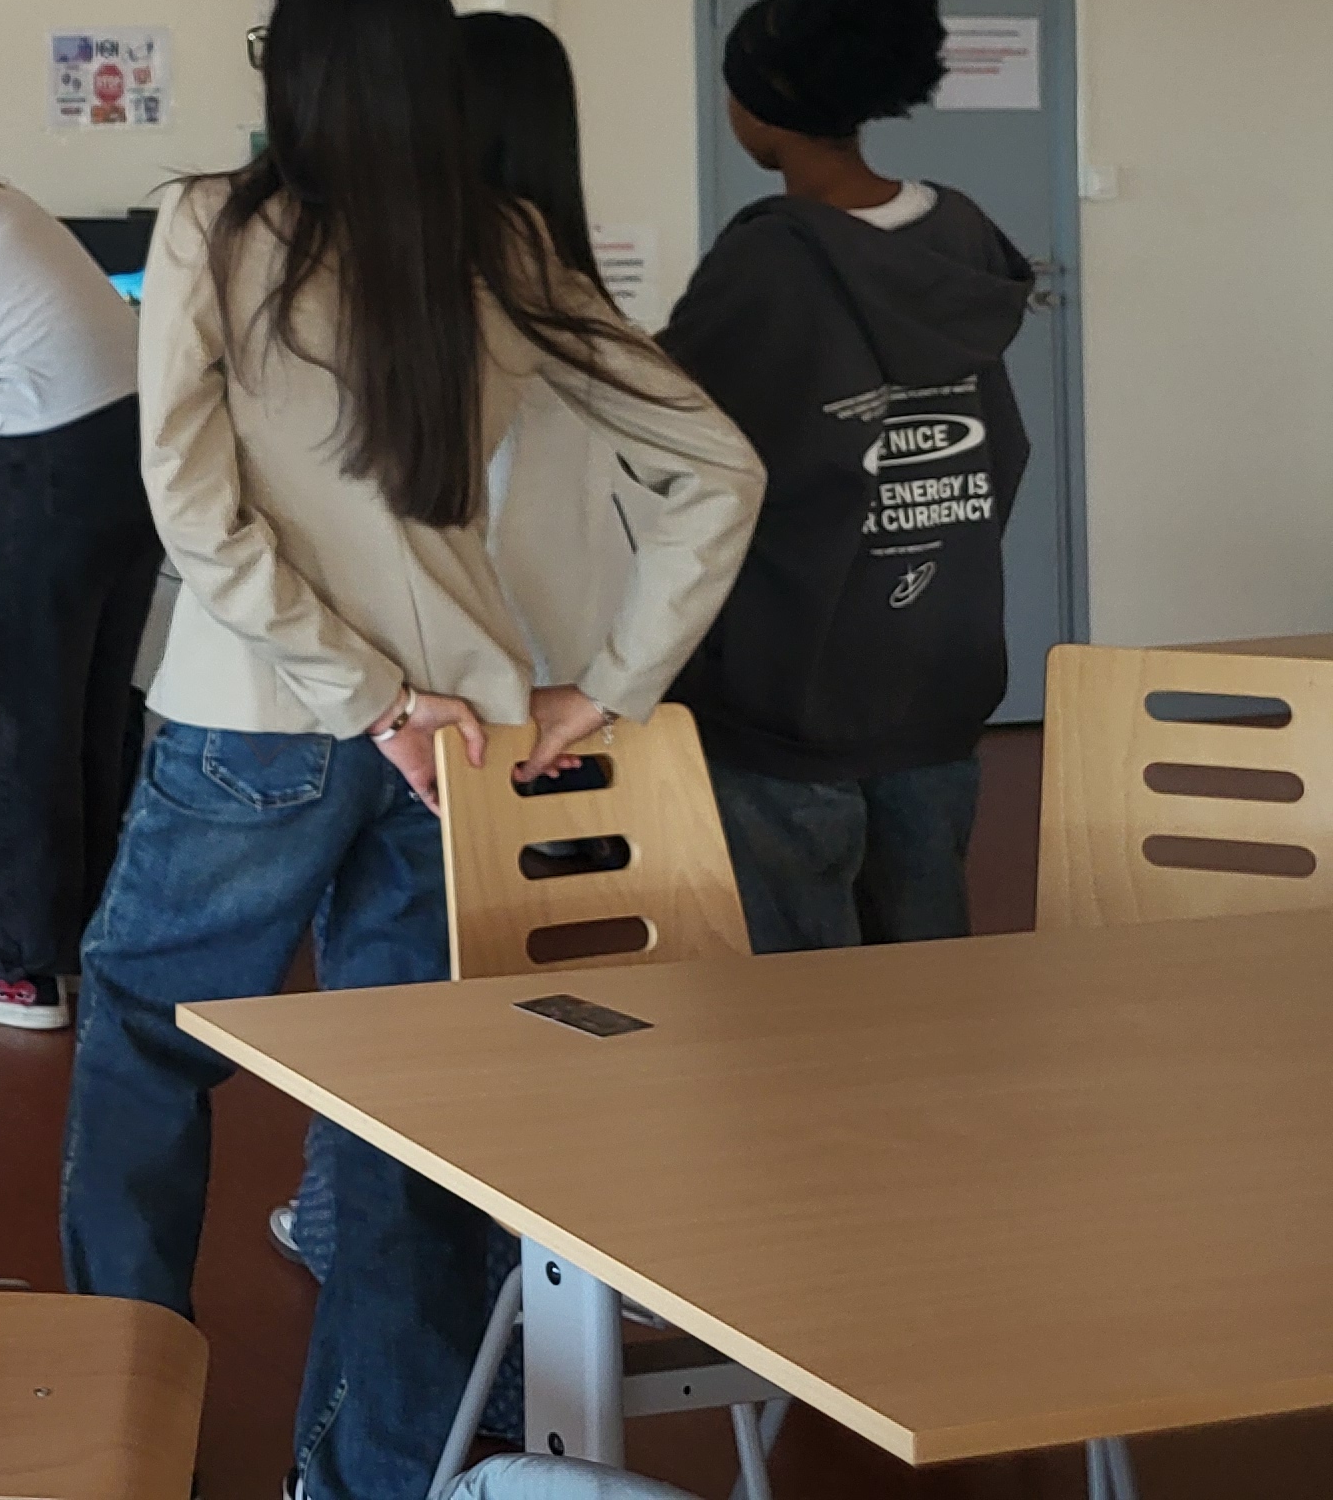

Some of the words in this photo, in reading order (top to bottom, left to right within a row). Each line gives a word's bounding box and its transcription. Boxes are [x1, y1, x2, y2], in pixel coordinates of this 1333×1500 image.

[888, 424, 949, 453] NICE
[879, 473, 965, 507] ENERGY
[967, 470, 990, 497] IS
[883, 496, 993, 531] CURRENCY
